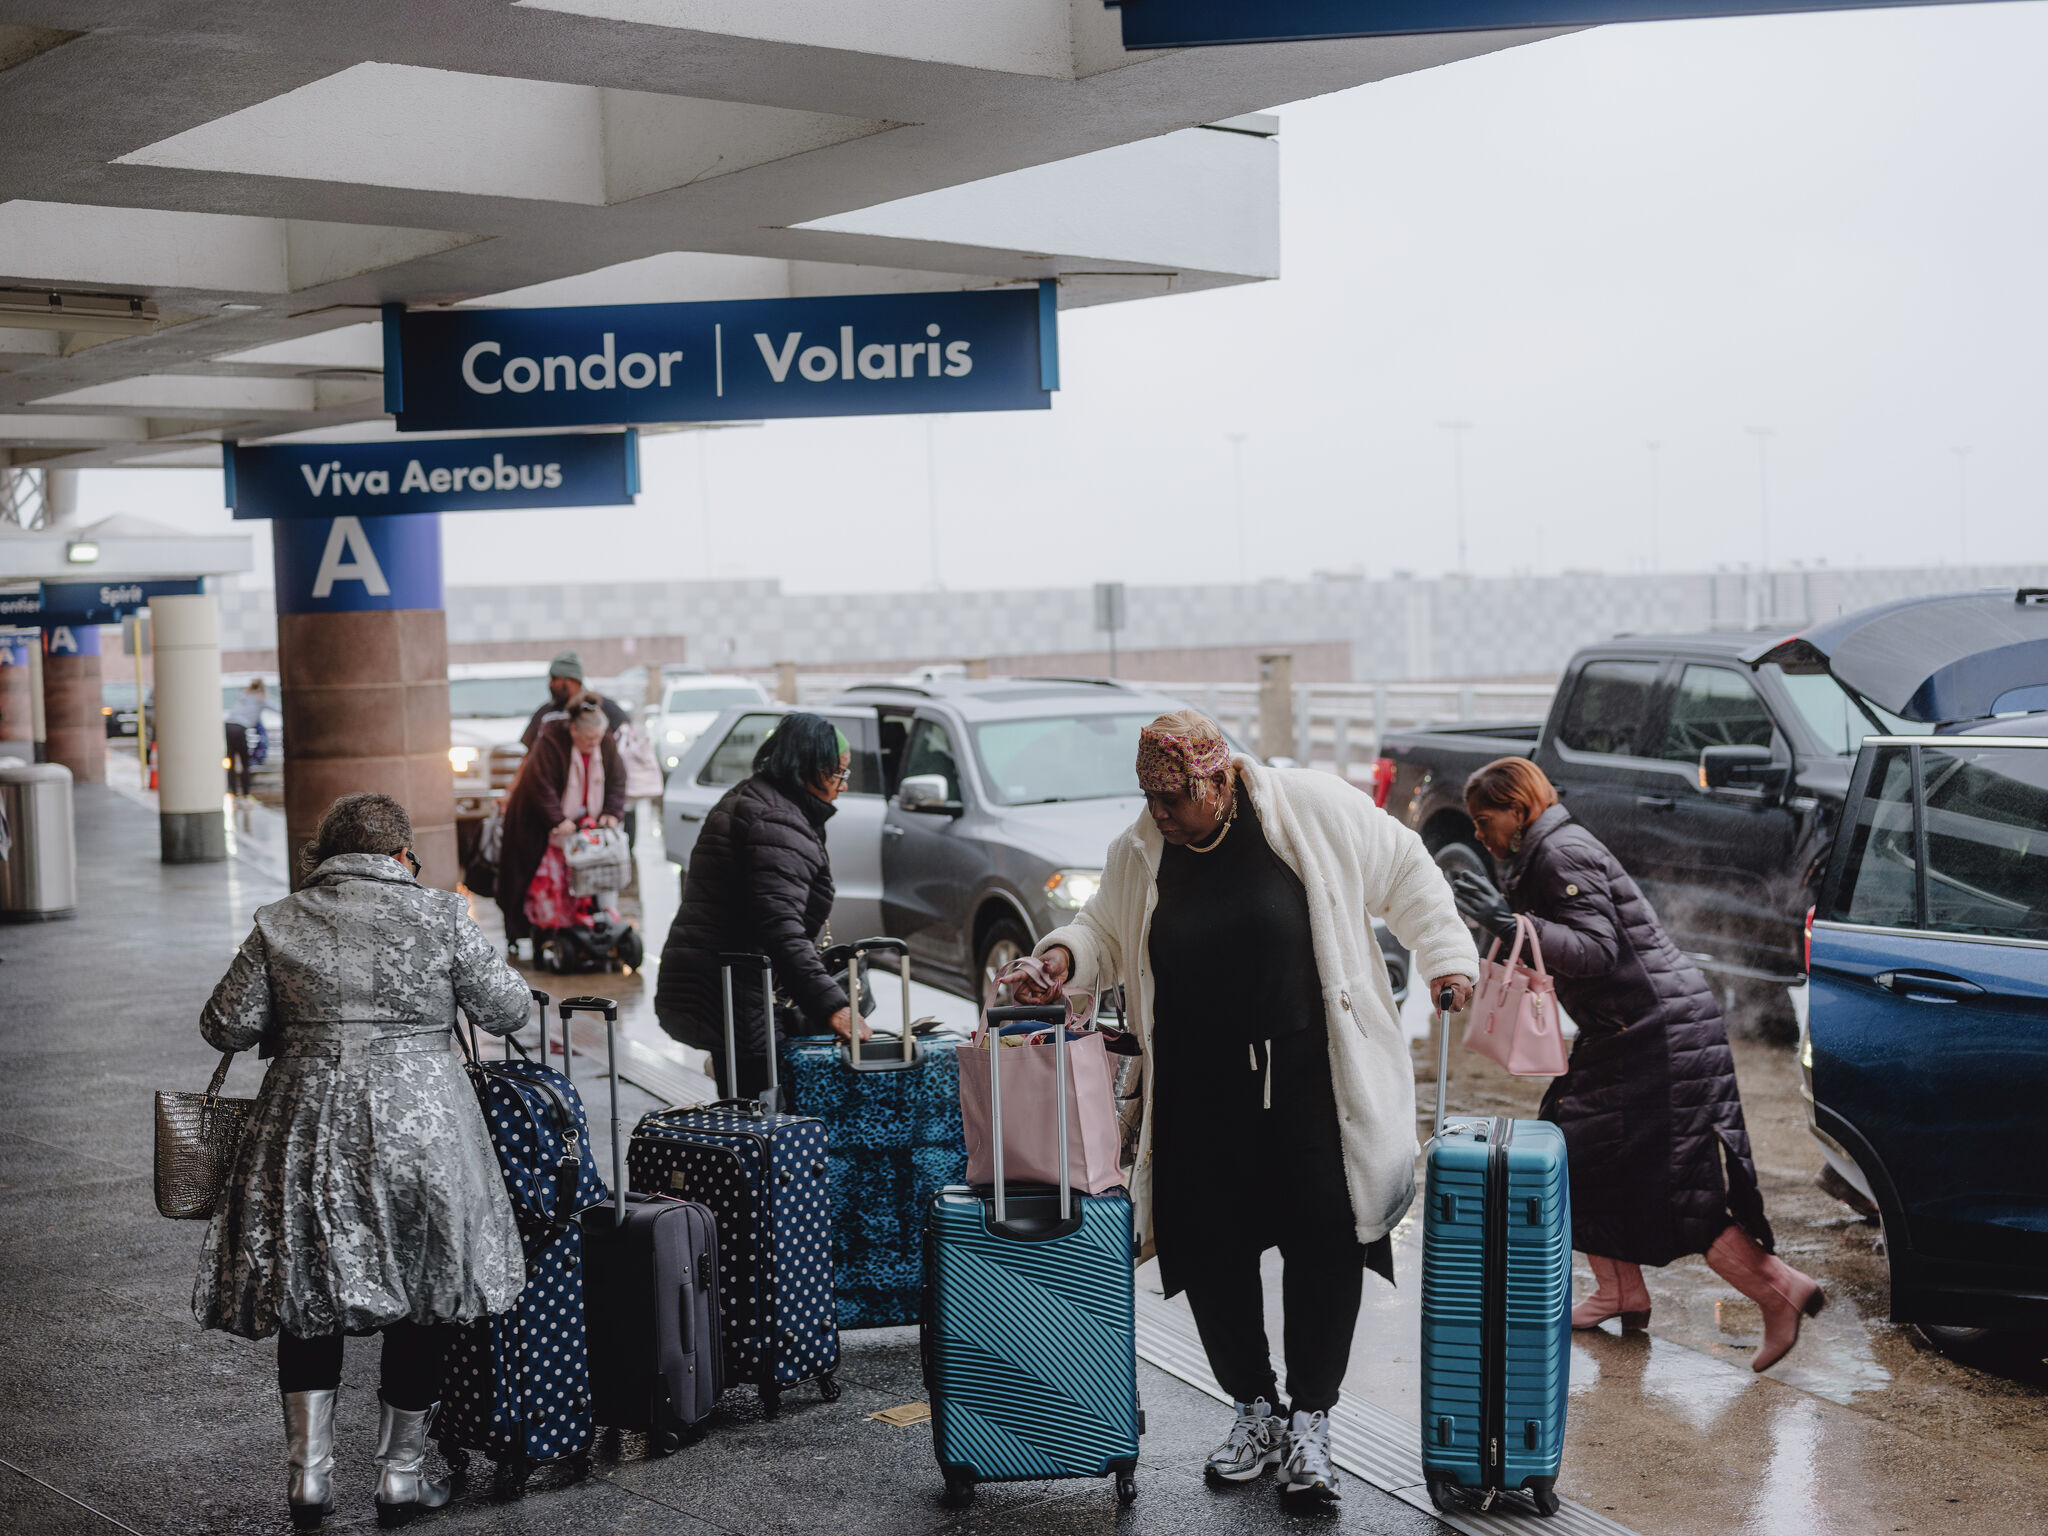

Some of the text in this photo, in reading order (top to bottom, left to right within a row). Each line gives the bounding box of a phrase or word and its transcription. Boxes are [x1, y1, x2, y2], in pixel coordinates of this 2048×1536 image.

[462, 323, 974, 394] Condor Volaris
[300, 453, 563, 497] Viva Aerobus
[311, 516, 391, 597] A
[100, 585, 143, 608] Spirit
[51, 626, 78, 653] A
